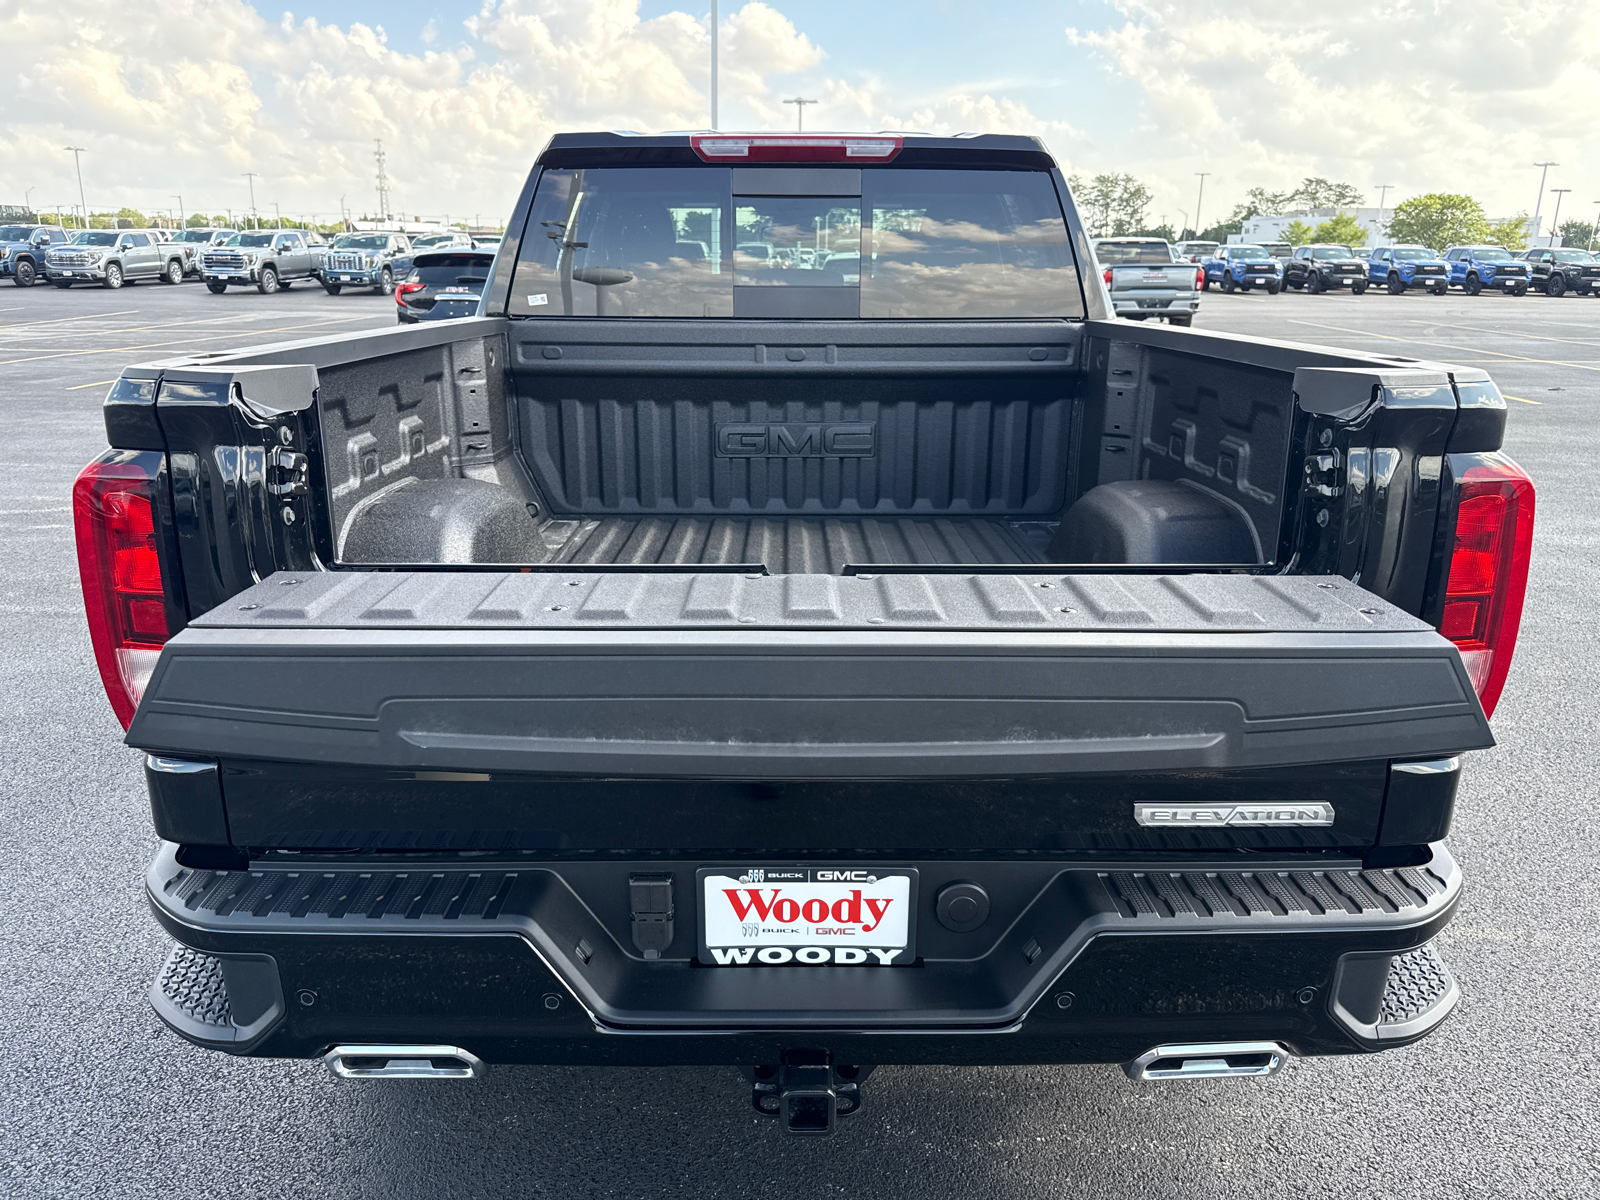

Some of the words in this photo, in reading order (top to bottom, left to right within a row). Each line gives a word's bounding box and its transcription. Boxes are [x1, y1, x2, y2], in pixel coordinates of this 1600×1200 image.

[718, 426, 873, 455] GMC
[1150, 810, 1320, 821] ELEVATION
[816, 870, 868, 881] GMC
[721, 888, 894, 932] Woody
[815, 927, 856, 935] GMC
[710, 947, 903, 965] WOODY
